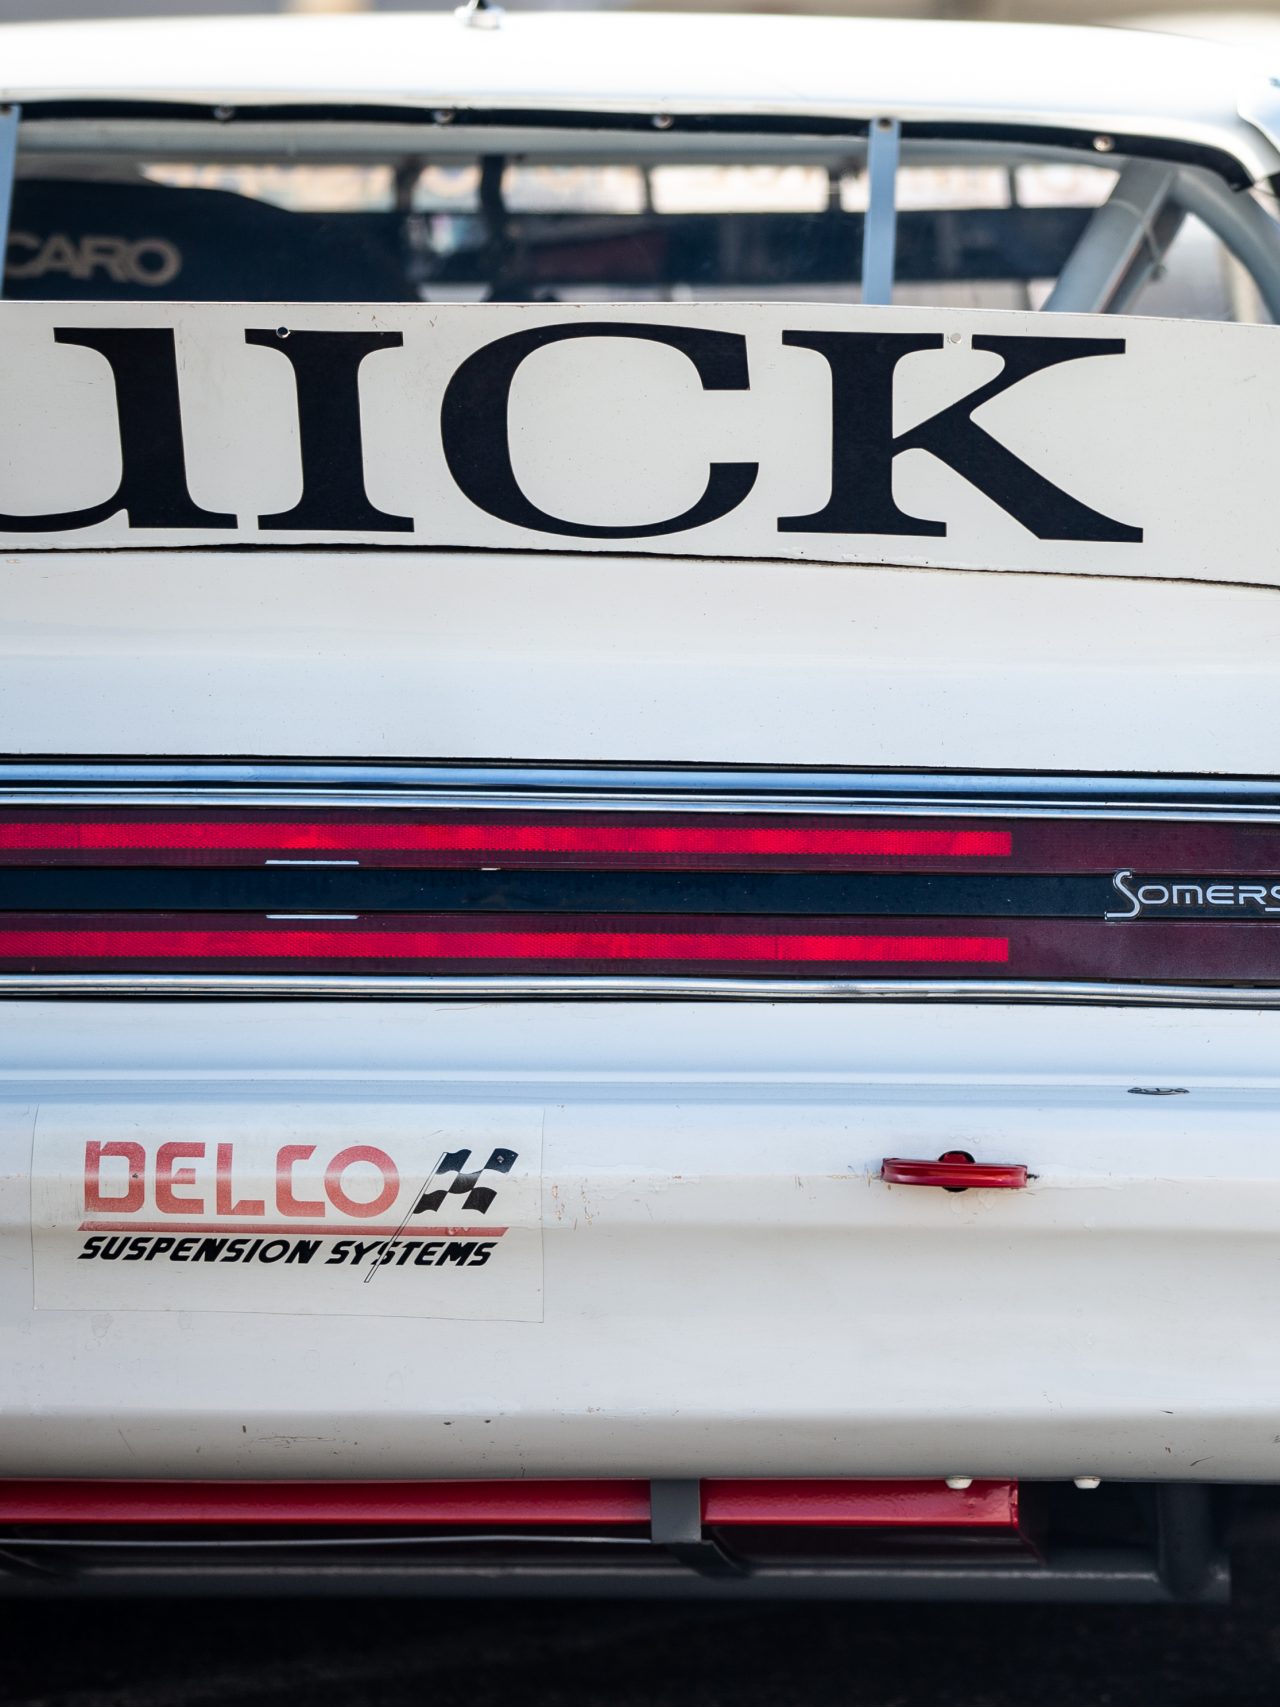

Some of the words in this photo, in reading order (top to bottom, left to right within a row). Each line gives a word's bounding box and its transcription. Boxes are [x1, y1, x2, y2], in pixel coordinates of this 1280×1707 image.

[5, 230, 183, 287] CARO
[83, 1140, 401, 1219] DELCO
[77, 1236, 325, 1264] SUSPENSION
[324, 1240, 499, 1268] SYSTEMS
